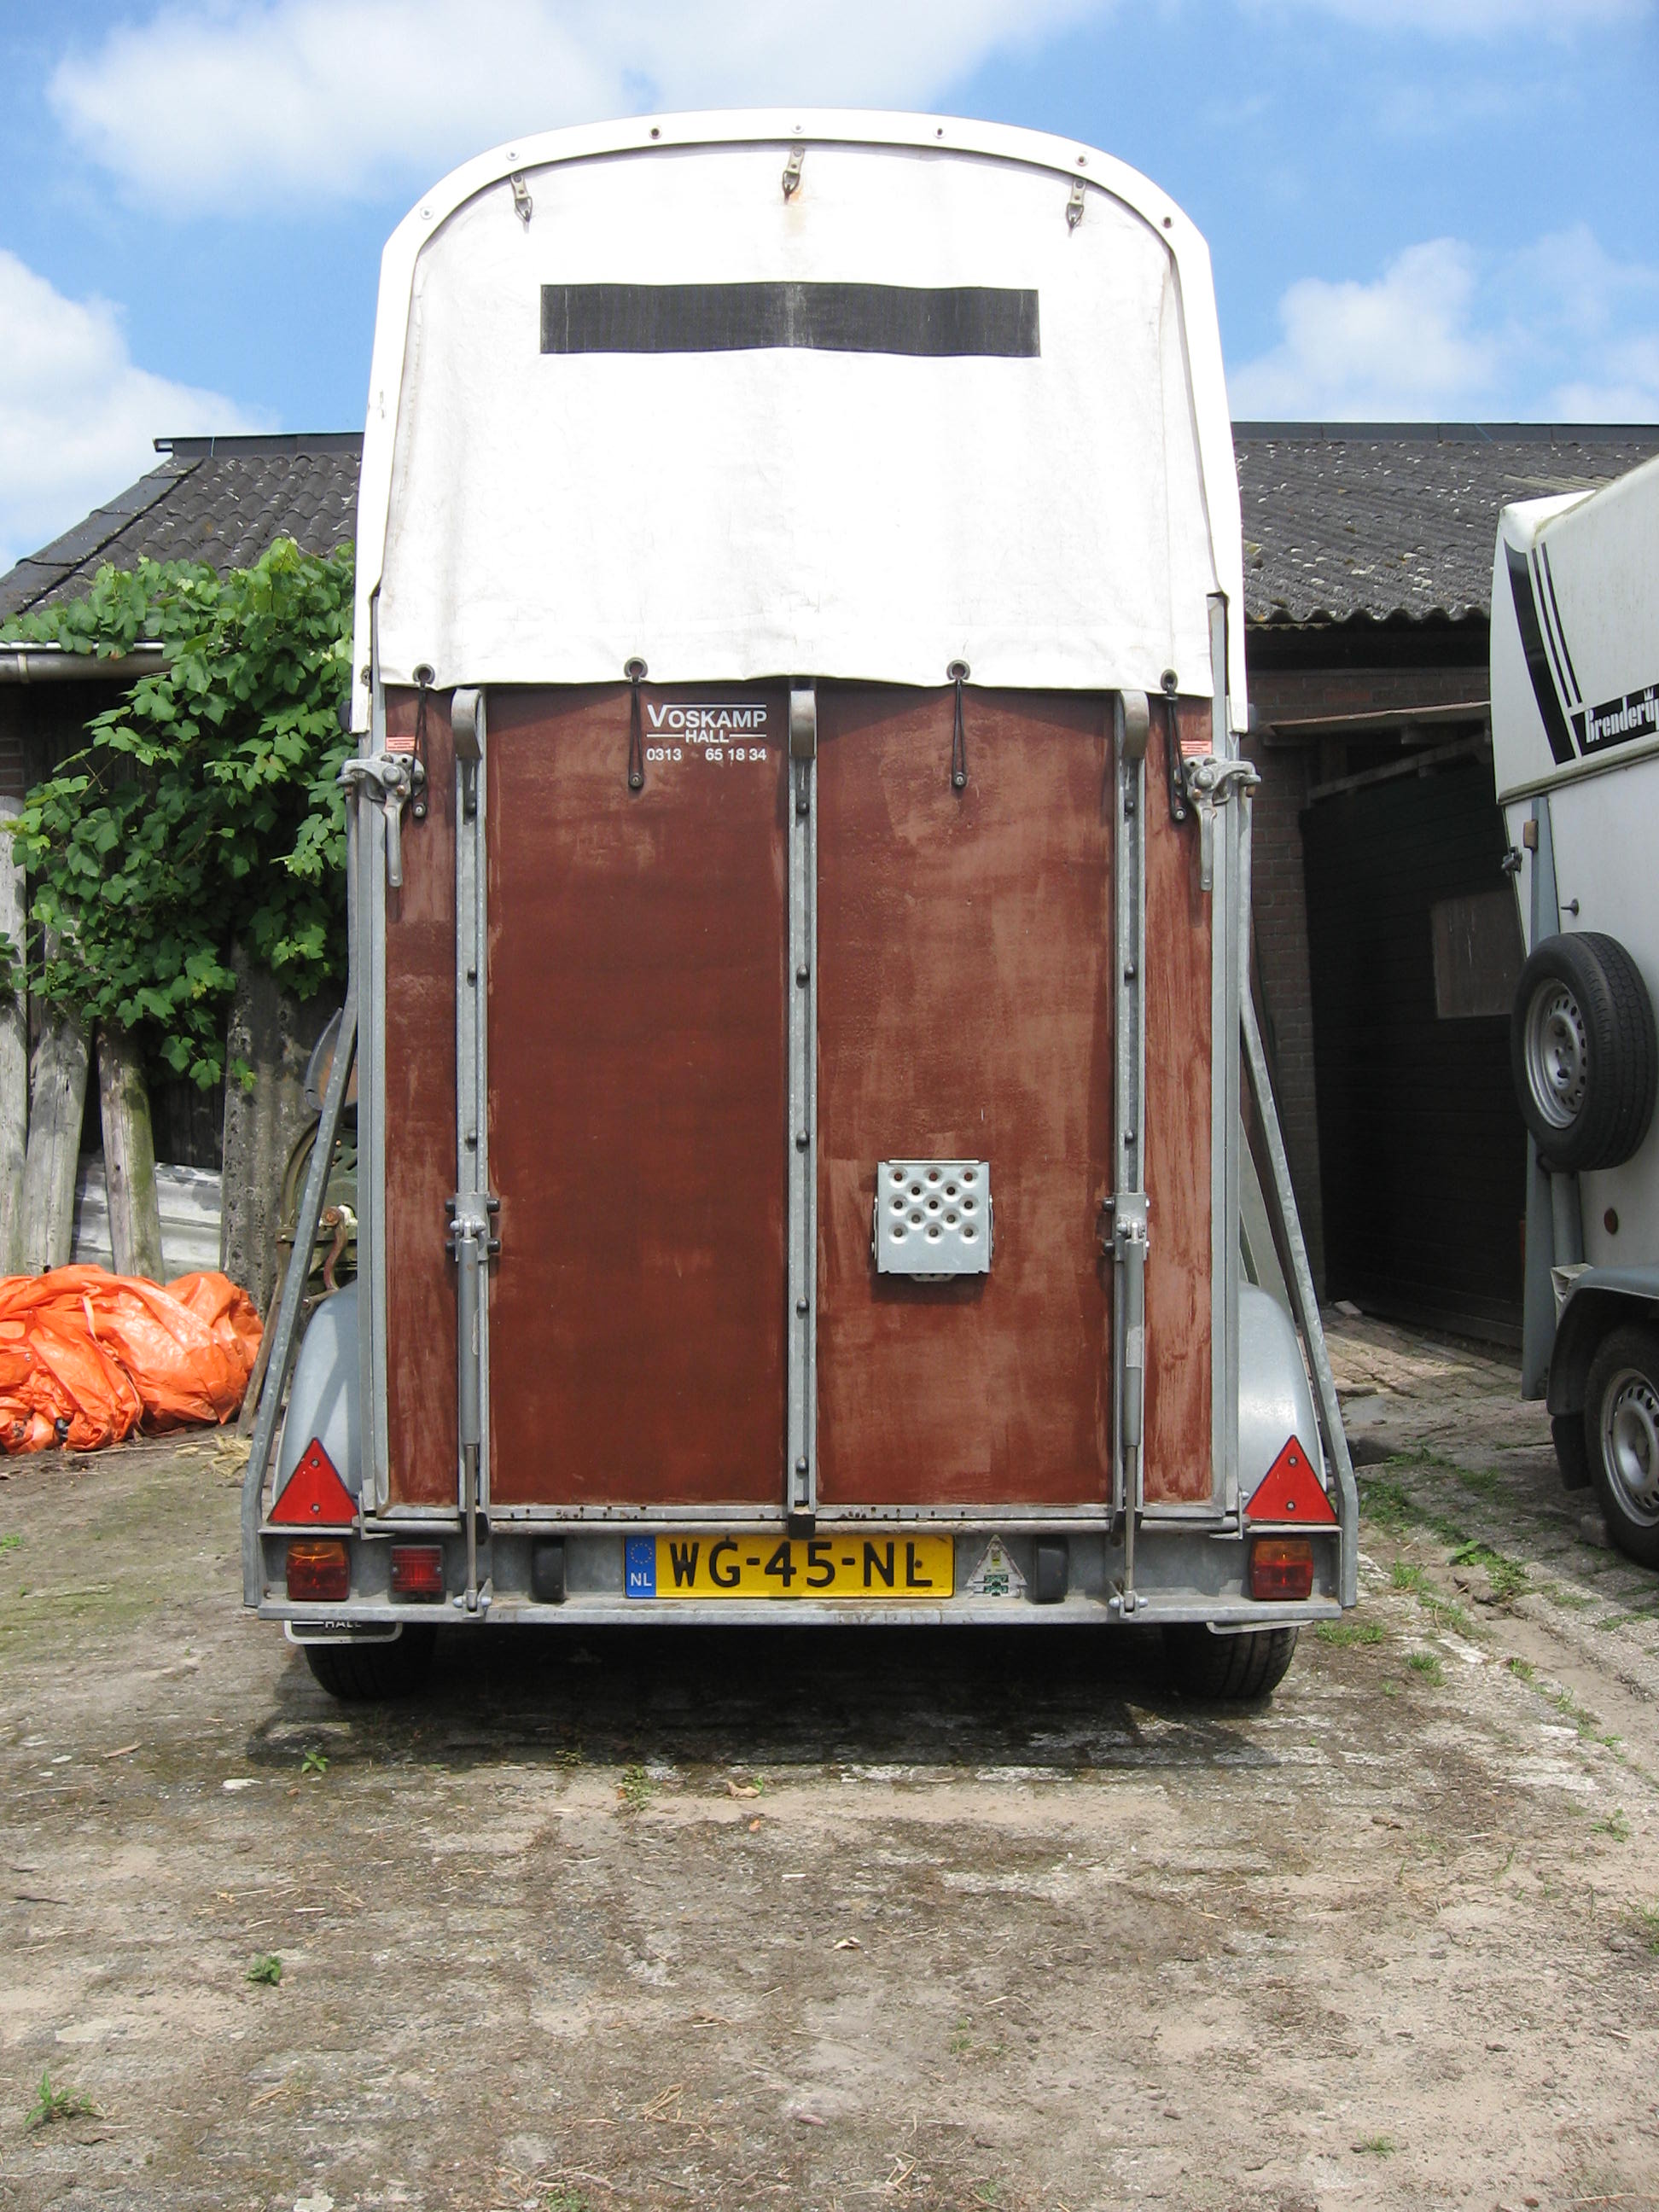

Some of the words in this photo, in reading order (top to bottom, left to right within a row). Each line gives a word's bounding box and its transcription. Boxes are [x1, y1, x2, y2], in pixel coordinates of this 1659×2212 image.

[647, 704, 767, 728] VOSKAMP
[685, 729, 730, 743] HALL
[646, 748, 682, 761] 0313
[705, 748, 724, 761] 65
[728, 748, 745, 761] 18
[748, 748, 767, 761] 34
[669, 1541, 933, 1588] WG-45-NL
[631, 1572, 653, 1586] NL
